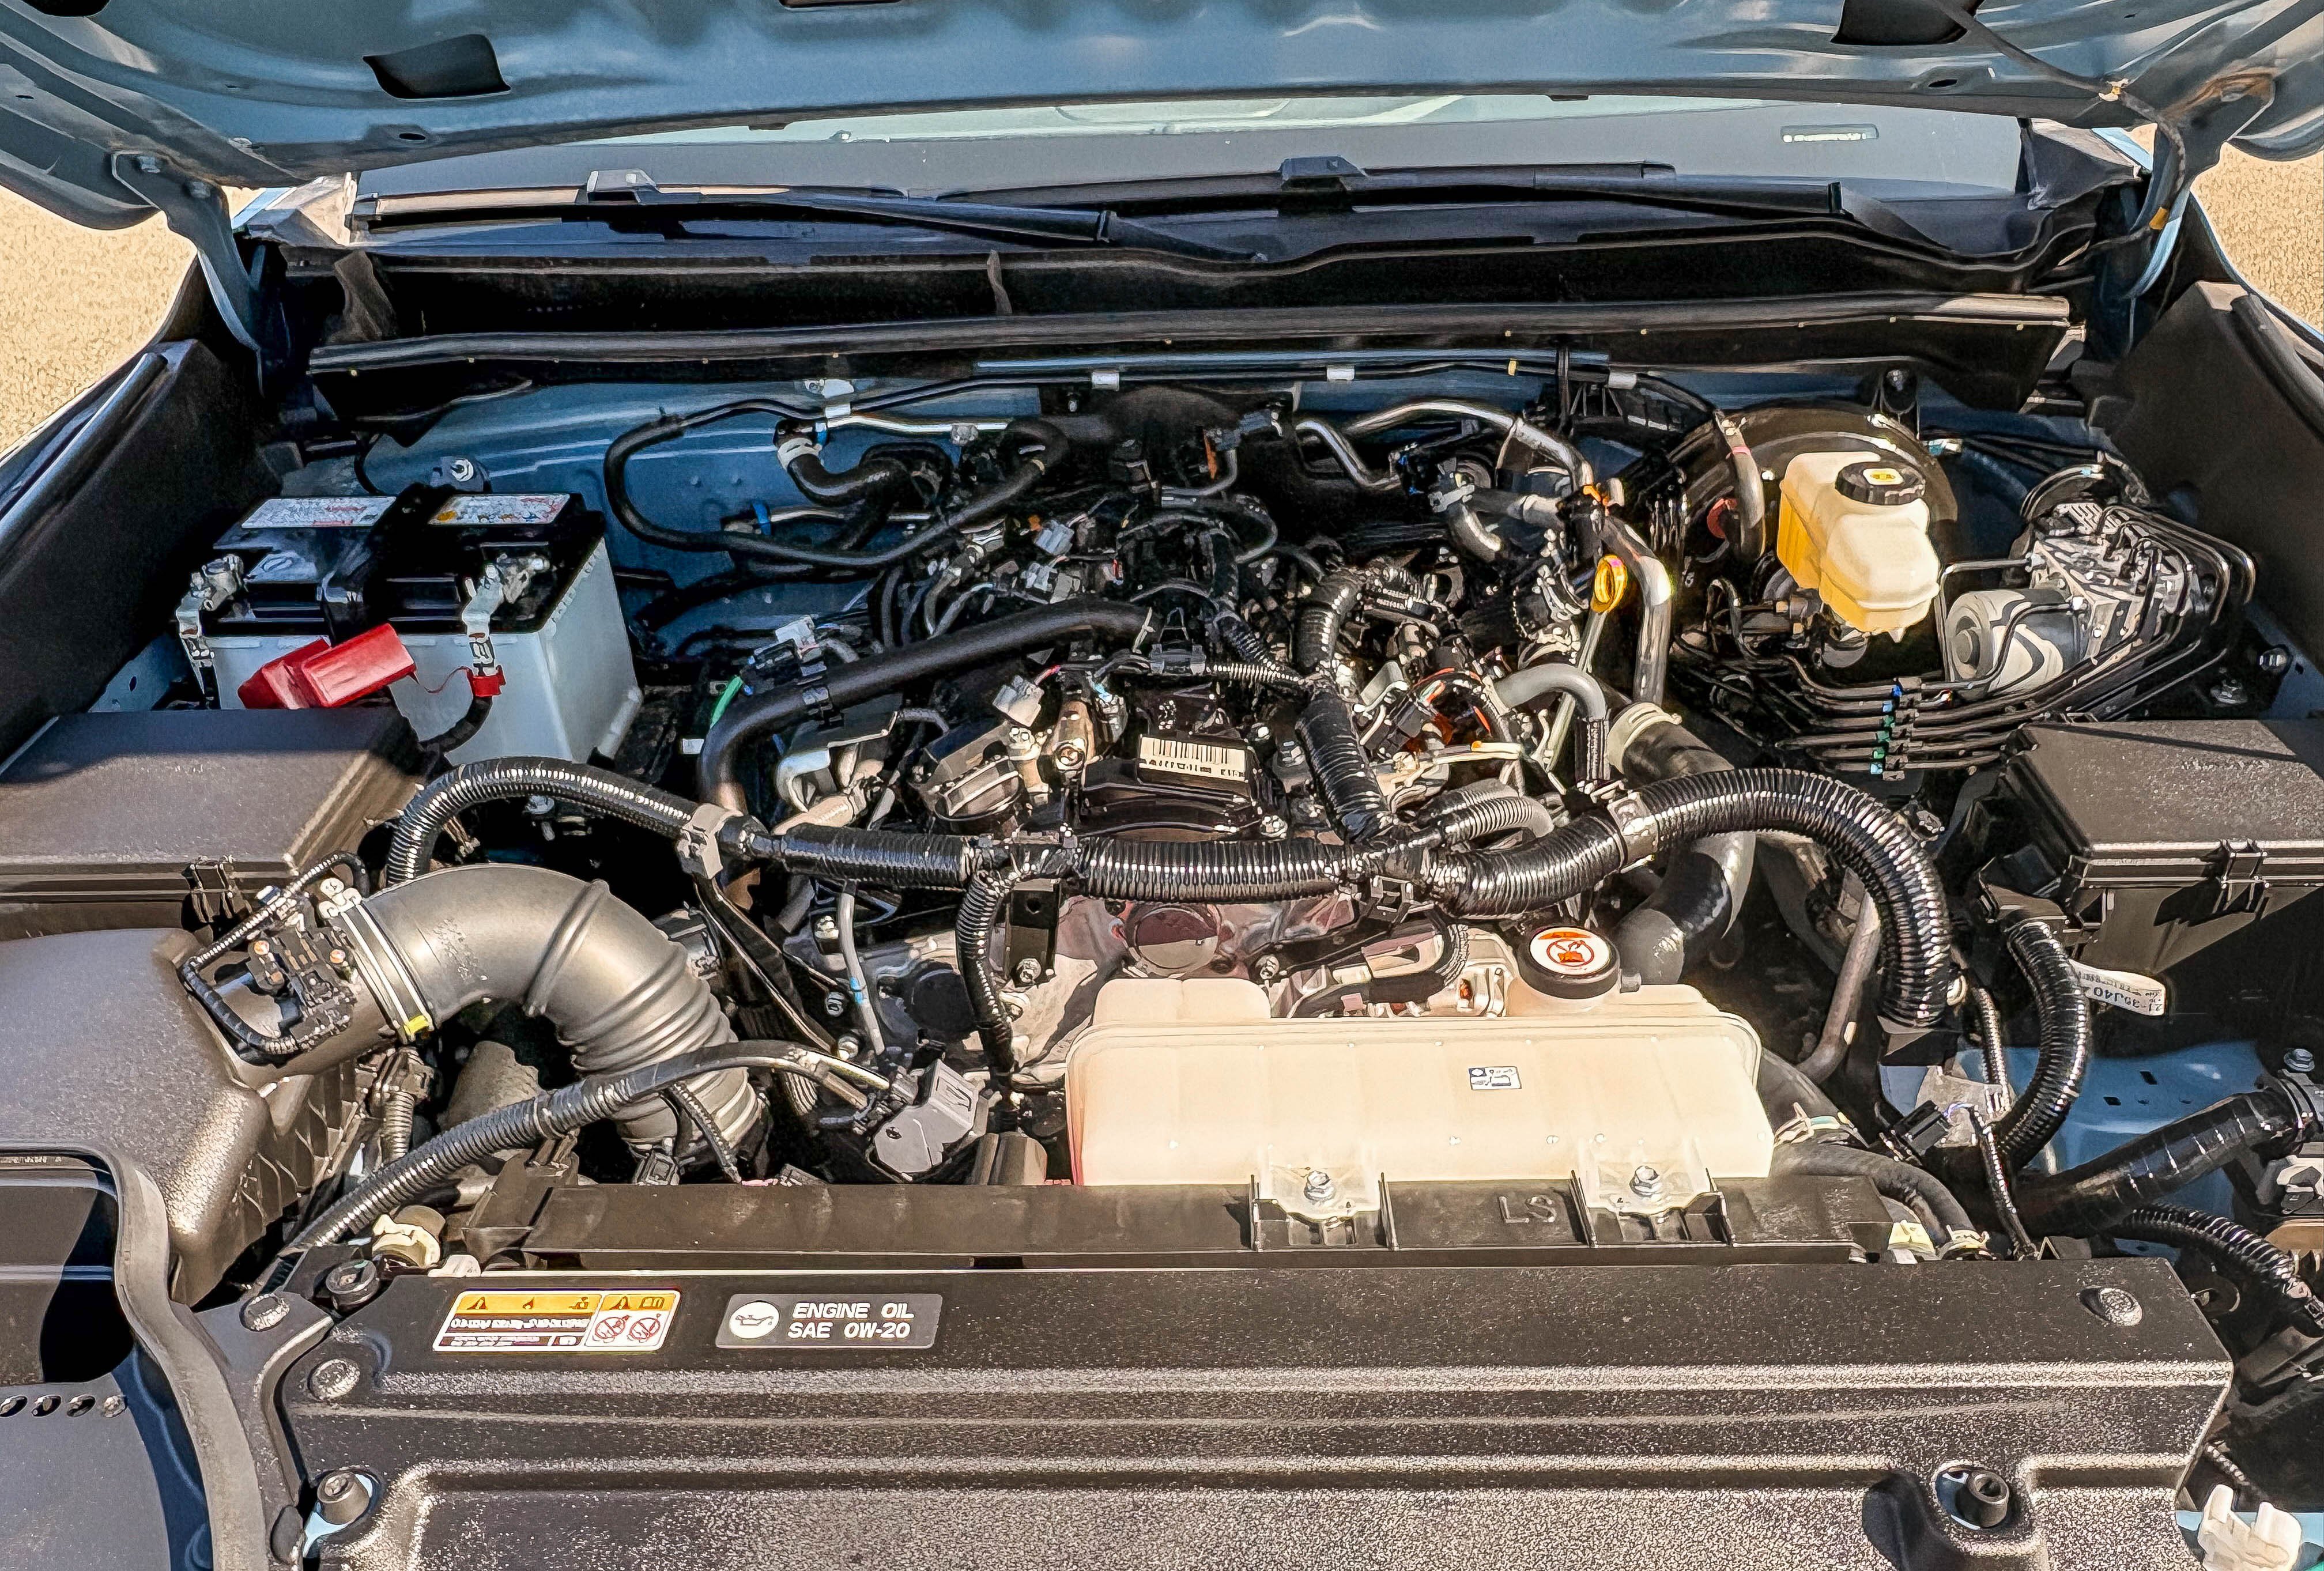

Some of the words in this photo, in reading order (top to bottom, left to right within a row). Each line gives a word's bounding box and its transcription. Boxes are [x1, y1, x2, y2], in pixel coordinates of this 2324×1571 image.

[1498, 1195, 1556, 1223] LS
[792, 1302, 870, 1319] ENGINE
[881, 1302, 915, 1319] OIL
[787, 1322, 833, 1339] SAE
[843, 1322, 911, 1339] 0W-20
